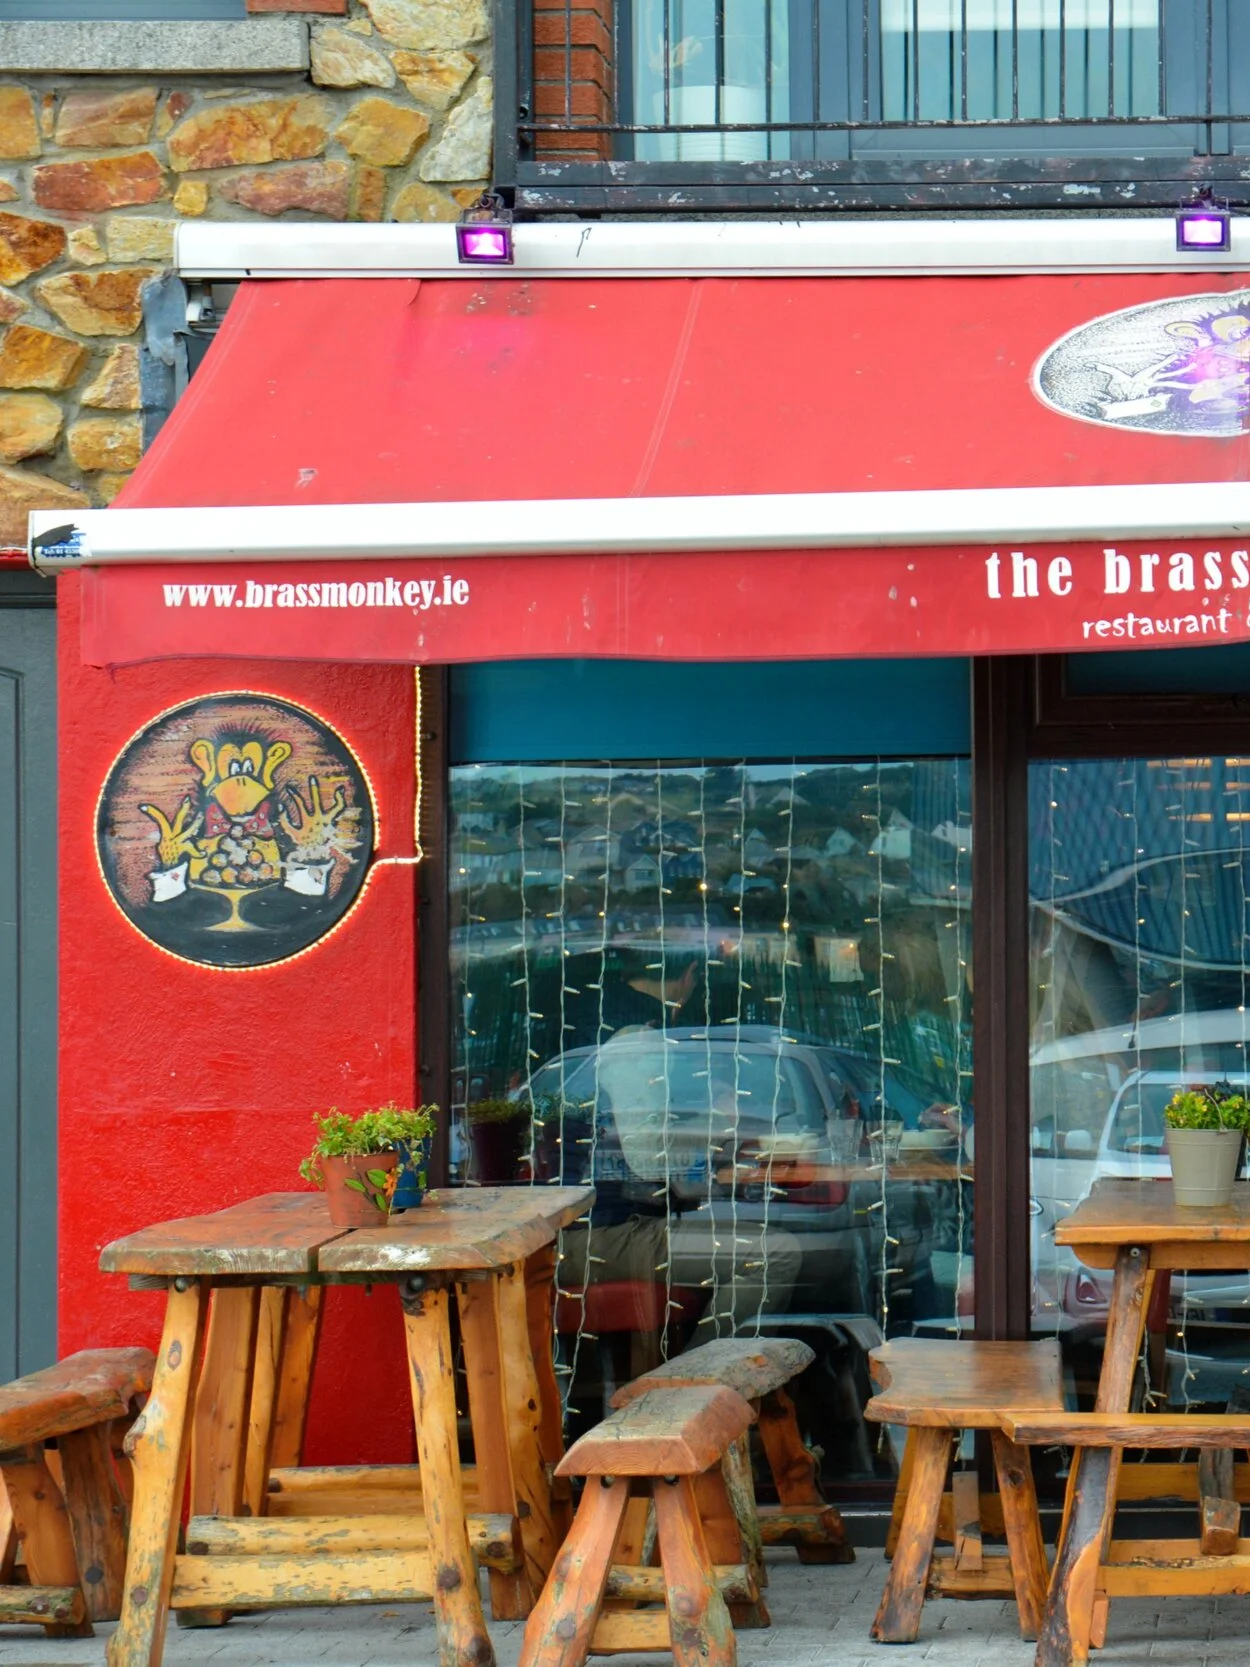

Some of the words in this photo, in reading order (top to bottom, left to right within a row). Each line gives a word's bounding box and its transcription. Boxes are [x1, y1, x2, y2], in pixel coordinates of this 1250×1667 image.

[985, 552, 1073, 599] the
[1103, 548, 1250, 594] brass
[162, 575, 470, 610] www.brassmonkey.ie
[1082, 608, 1232, 639] restaurant
